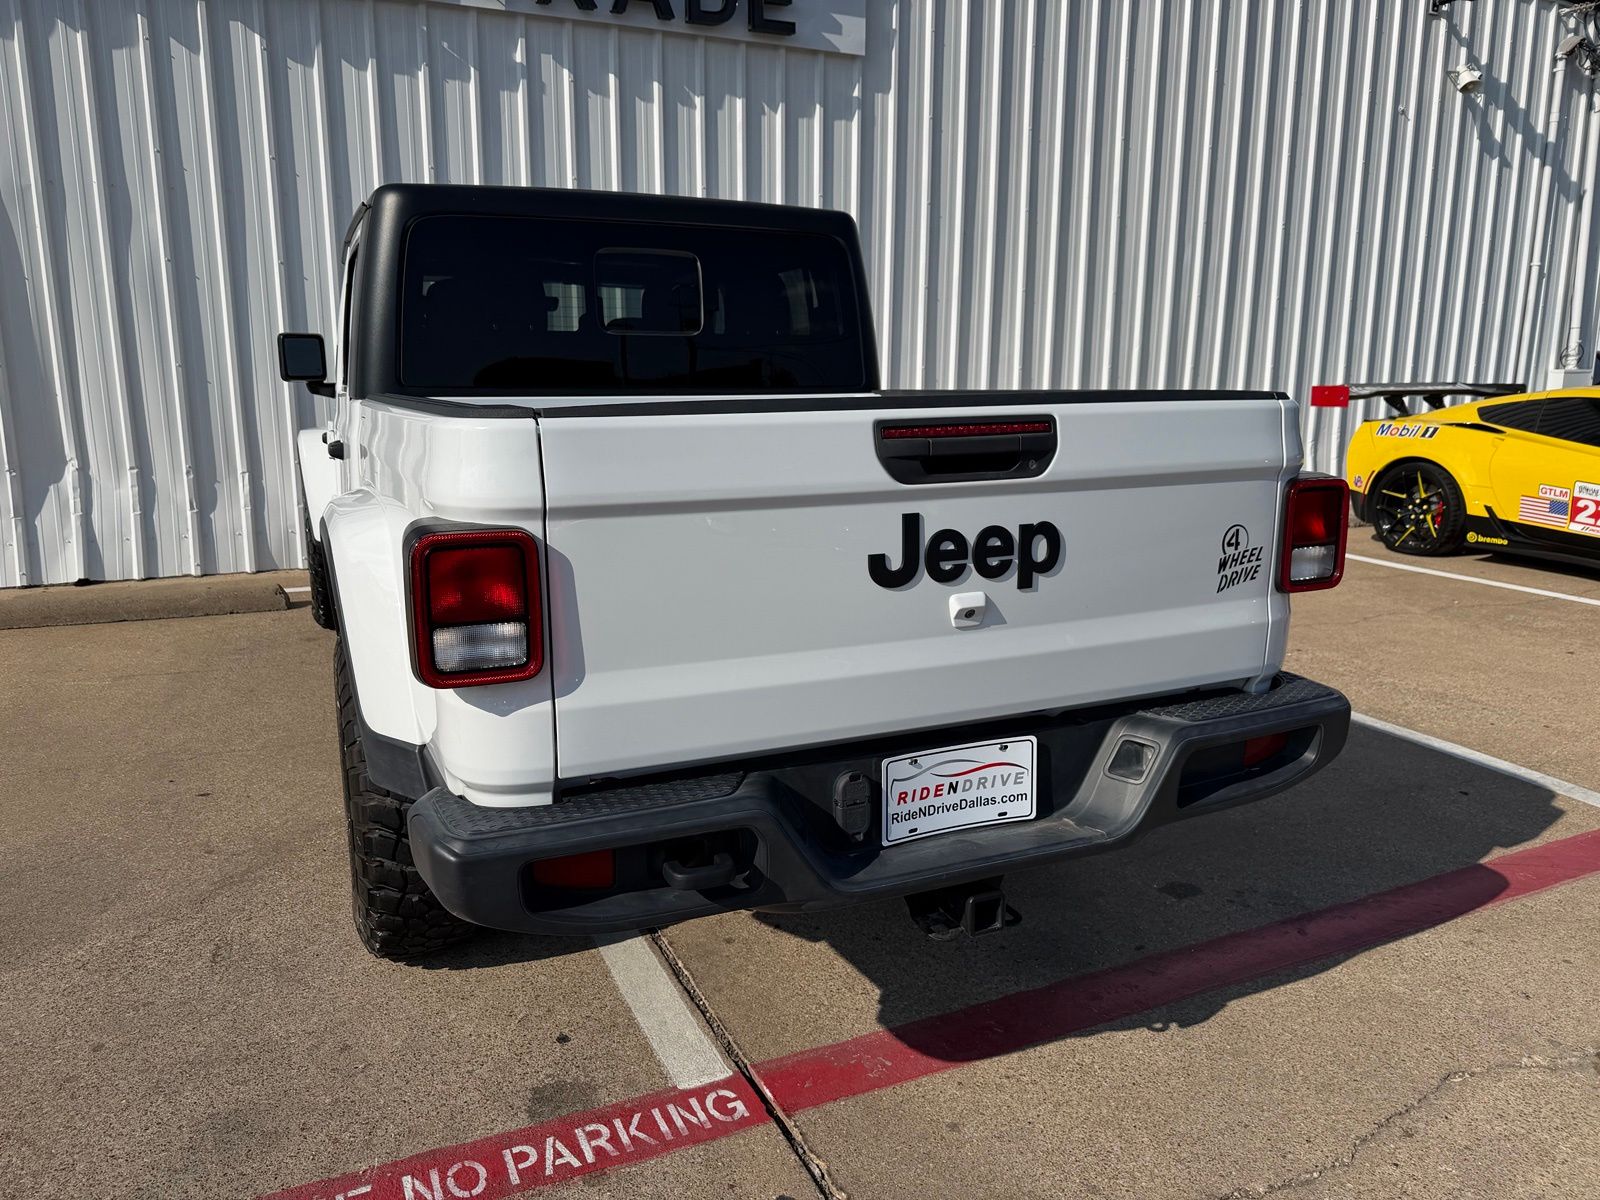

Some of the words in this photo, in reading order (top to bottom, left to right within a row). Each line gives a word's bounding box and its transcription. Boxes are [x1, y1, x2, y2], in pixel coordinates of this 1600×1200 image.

[1376, 423, 1422, 438] Mobil
[1540, 486, 1569, 499] GTLM
[1574, 499, 1600, 527] 2
[867, 512, 1062, 591] Jeep
[1226, 528, 1241, 551] 4
[1477, 534, 1509, 546] brembo
[1217, 545, 1264, 575] WHEEL
[1216, 564, 1262, 594] DRIVE
[891, 792, 1029, 825] RideNDriveDallas.com
[401, 1160, 488, 1200] NO
[501, 1088, 751, 1186] PARKING
